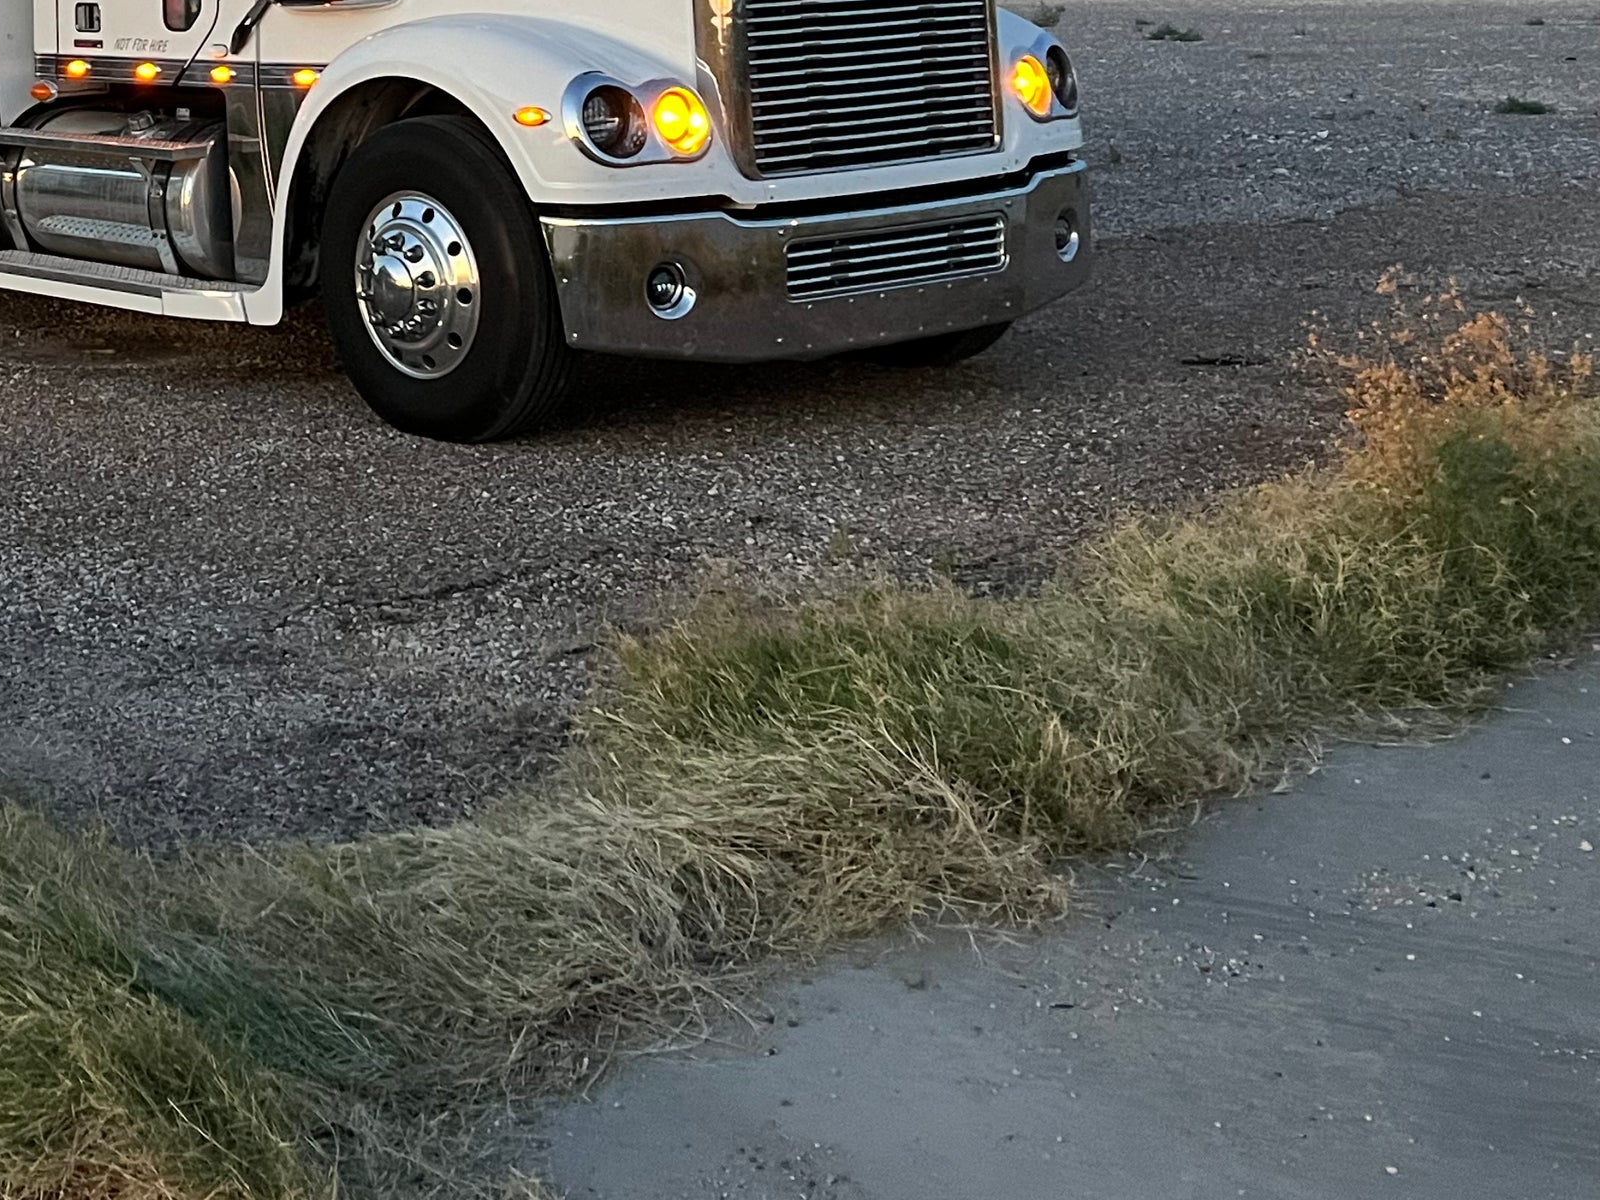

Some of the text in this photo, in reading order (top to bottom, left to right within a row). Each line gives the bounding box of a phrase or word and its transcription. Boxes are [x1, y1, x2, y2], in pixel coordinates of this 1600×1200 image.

[114, 38, 169, 53] NOT FOR HIRE
